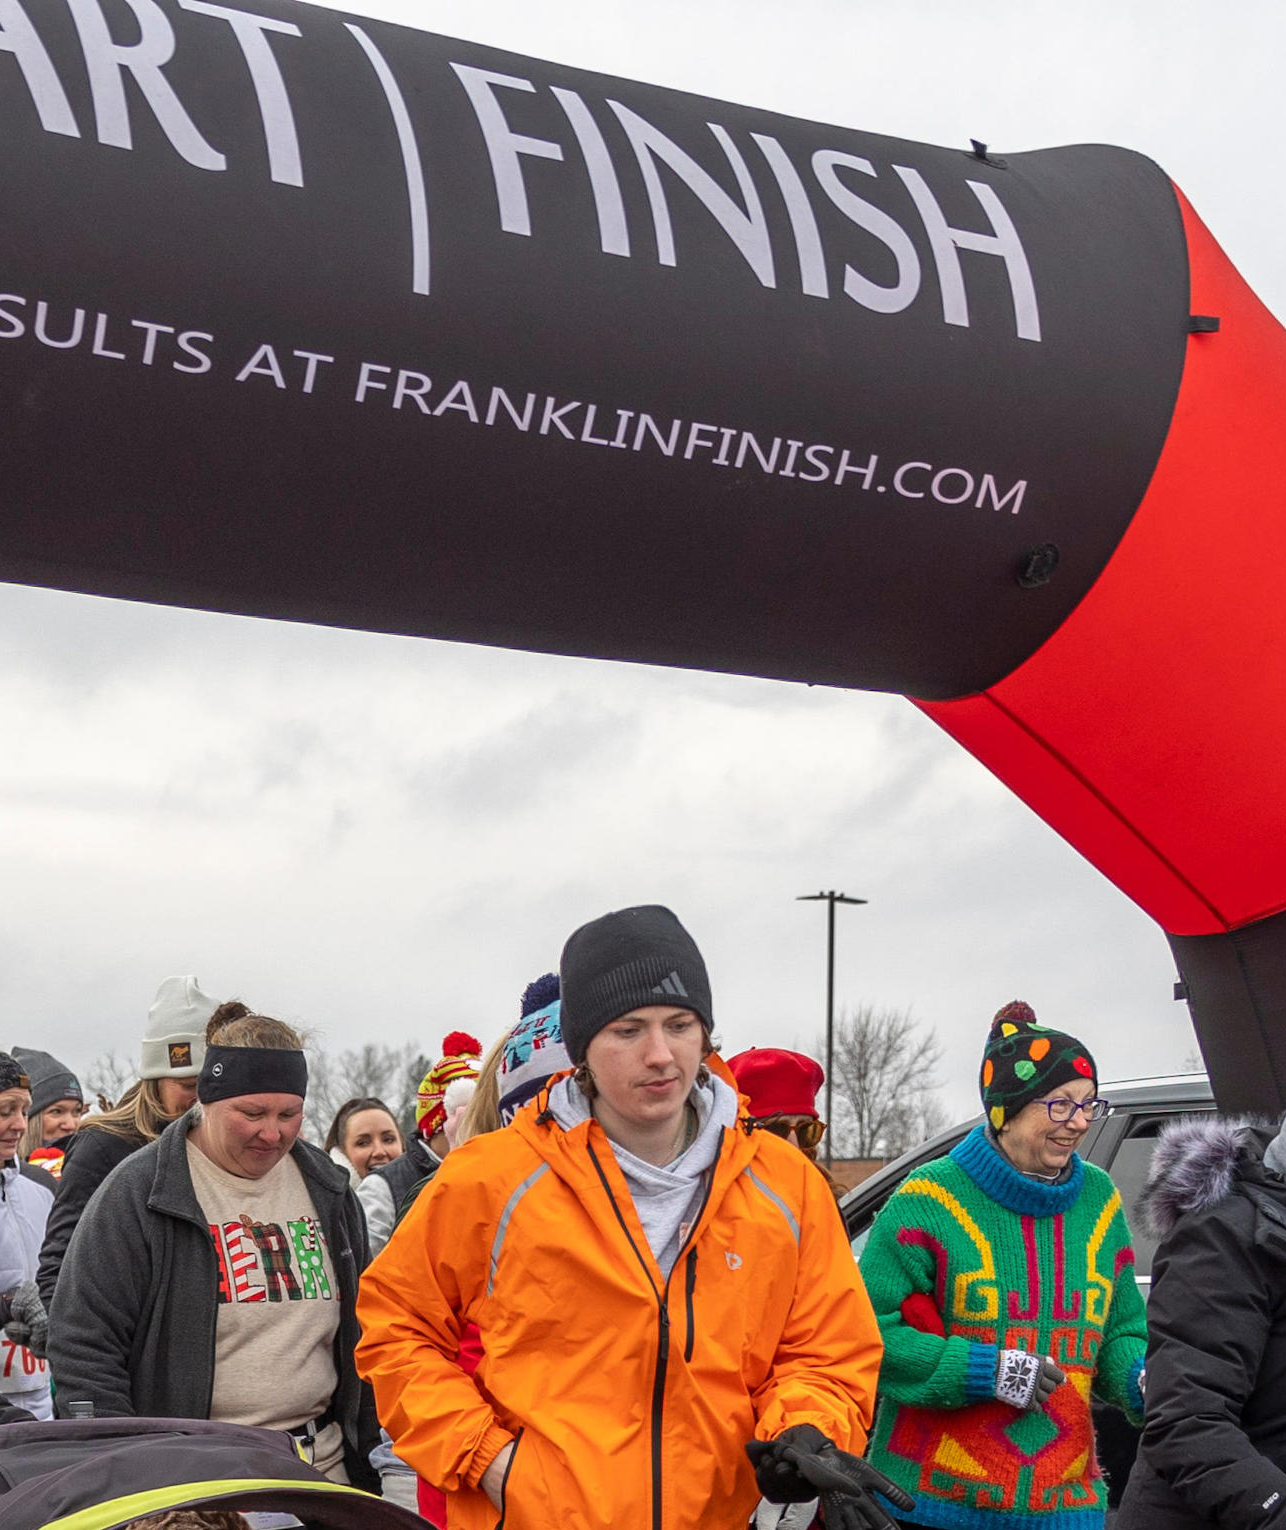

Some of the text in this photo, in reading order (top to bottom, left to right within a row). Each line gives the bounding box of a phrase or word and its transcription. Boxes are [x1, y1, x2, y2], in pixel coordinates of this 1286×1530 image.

[450, 62, 1041, 342] FINISH
[235, 344, 333, 393] AT
[354, 362, 1027, 515] FRANKLINFINISH.COM
[208, 1216, 340, 1303] ERR
